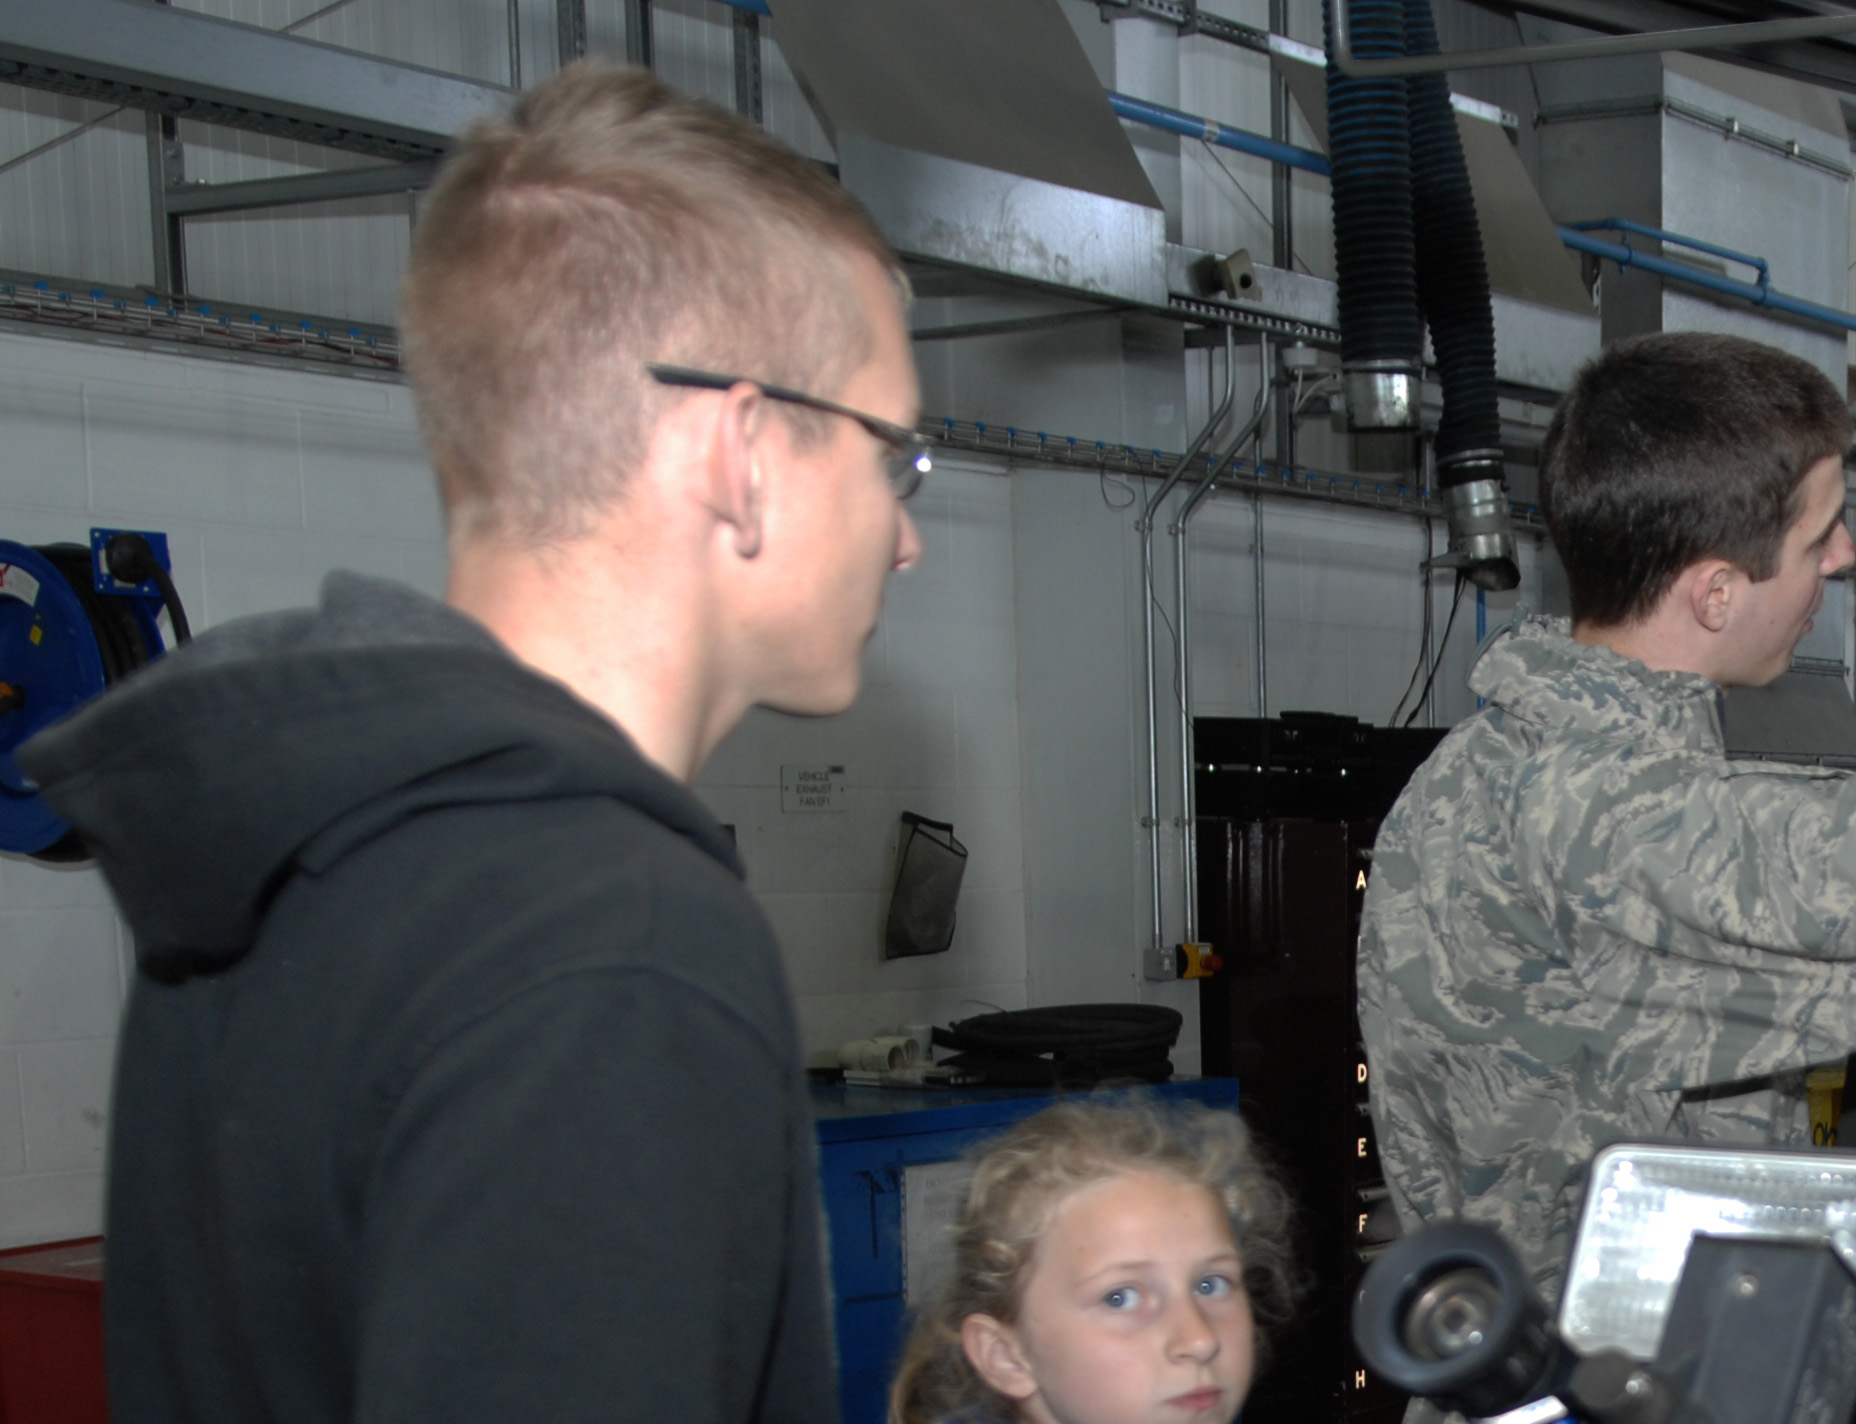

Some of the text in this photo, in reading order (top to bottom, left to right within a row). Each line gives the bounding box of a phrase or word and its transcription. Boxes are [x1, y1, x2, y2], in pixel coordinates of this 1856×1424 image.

[798, 771, 829, 781] VEHICLE
[796, 784, 832, 794] EXHAUST
[799, 796, 816, 806] FAN
[1355, 869, 1367, 891] A
[1357, 1063, 1368, 1083] D
[1357, 1137, 1368, 1157] E
[1358, 1213, 1368, 1233] F
[1355, 1369, 1366, 1389] H
